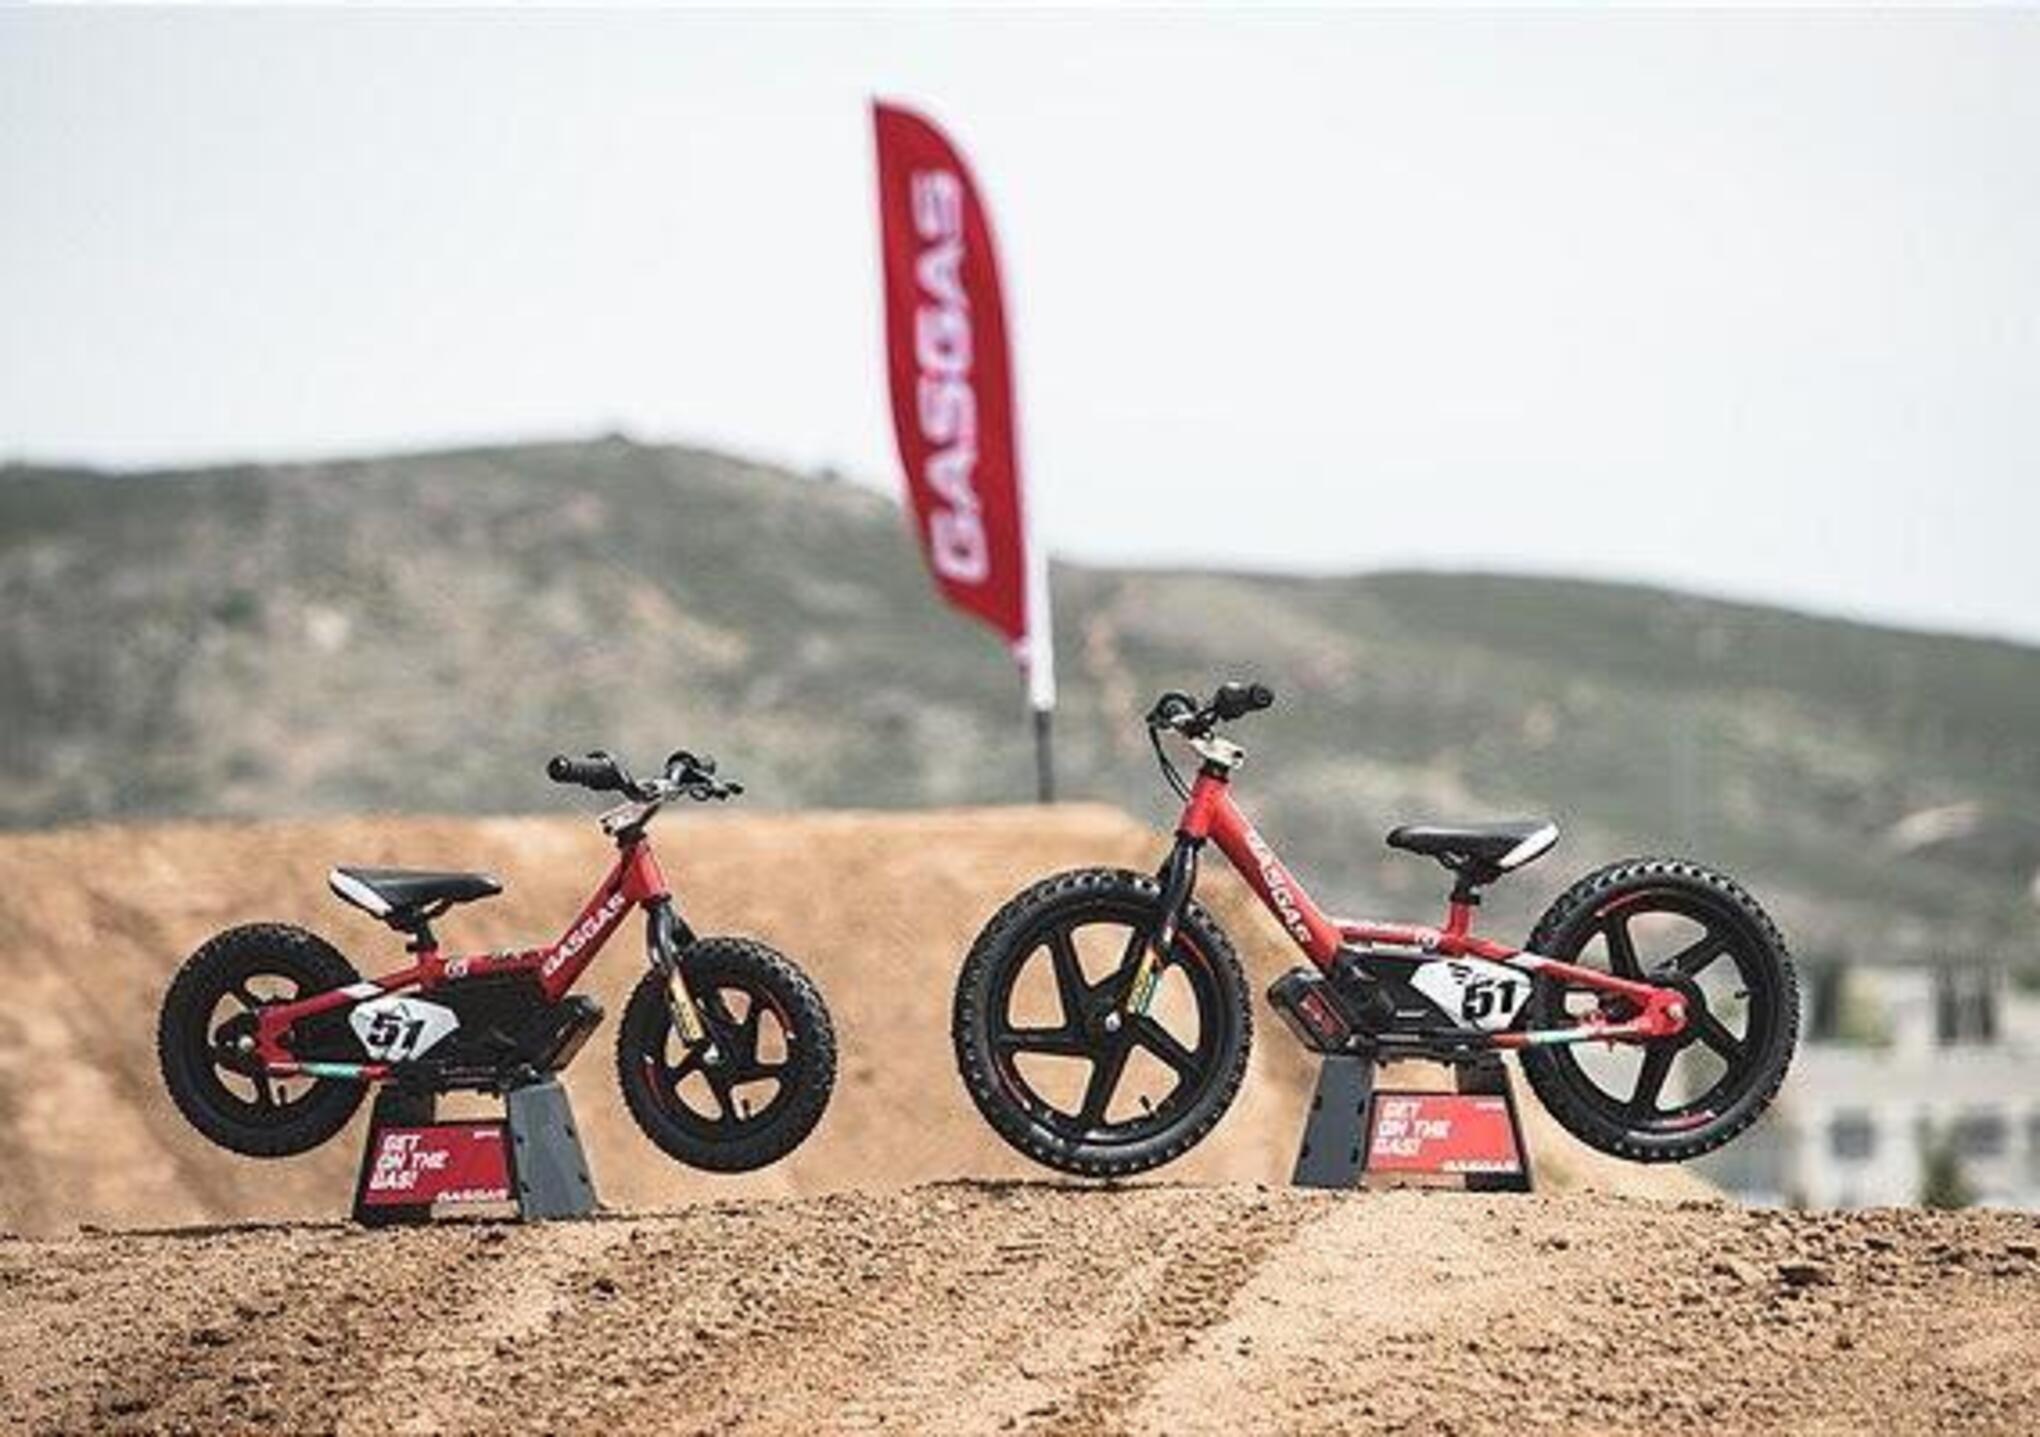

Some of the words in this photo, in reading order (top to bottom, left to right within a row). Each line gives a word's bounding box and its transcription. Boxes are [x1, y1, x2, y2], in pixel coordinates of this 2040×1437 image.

[910, 169, 990, 584] GASGAS
[541, 893, 626, 978] GASGAS
[1461, 980, 1517, 1021] 51
[366, 1012, 425, 1051] 51
[1383, 1101, 1422, 1118] GET
[382, 1134, 421, 1151] GET
[1378, 1120, 1408, 1137] ON
[1413, 1120, 1451, 1138] THE
[377, 1152, 406, 1169] ON
[411, 1152, 449, 1169] THE
